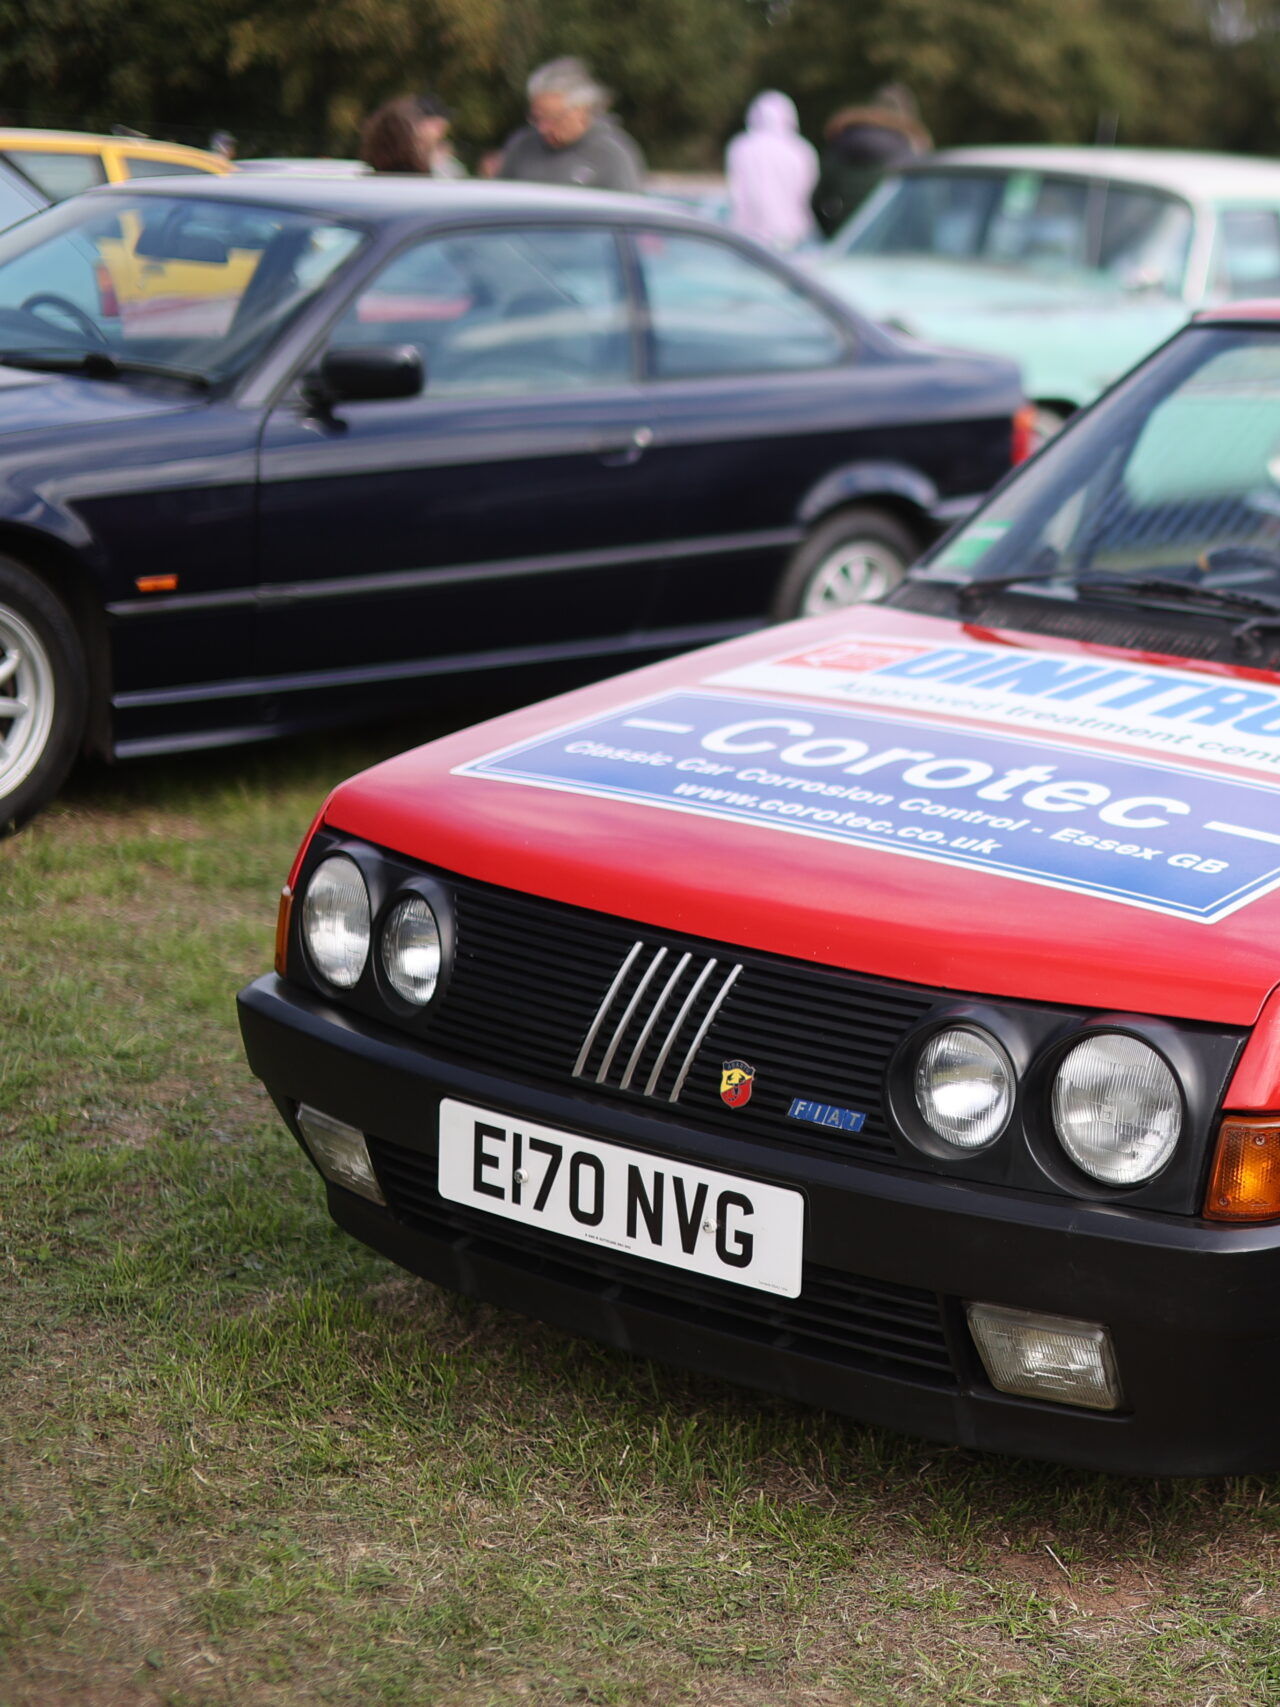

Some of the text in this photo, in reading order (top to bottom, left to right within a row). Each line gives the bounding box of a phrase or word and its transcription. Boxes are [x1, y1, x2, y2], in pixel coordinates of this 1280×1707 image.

[1005, 703, 1196, 745] treatment
[564, 740, 674, 767] Classic
[675, 757, 736, 776] Car
[735, 767, 895, 806] Corrosion
[898, 798, 1032, 832] Control
[1049, 827, 1164, 861] Essex
[1166, 853, 1230, 875] GB
[673, 782, 1003, 855] www.corotec.co.uk
[700, 718, 1192, 829] Corotec
[794, 1100, 861, 1128] FIAT
[473, 1120, 755, 1269] E170 NVG
